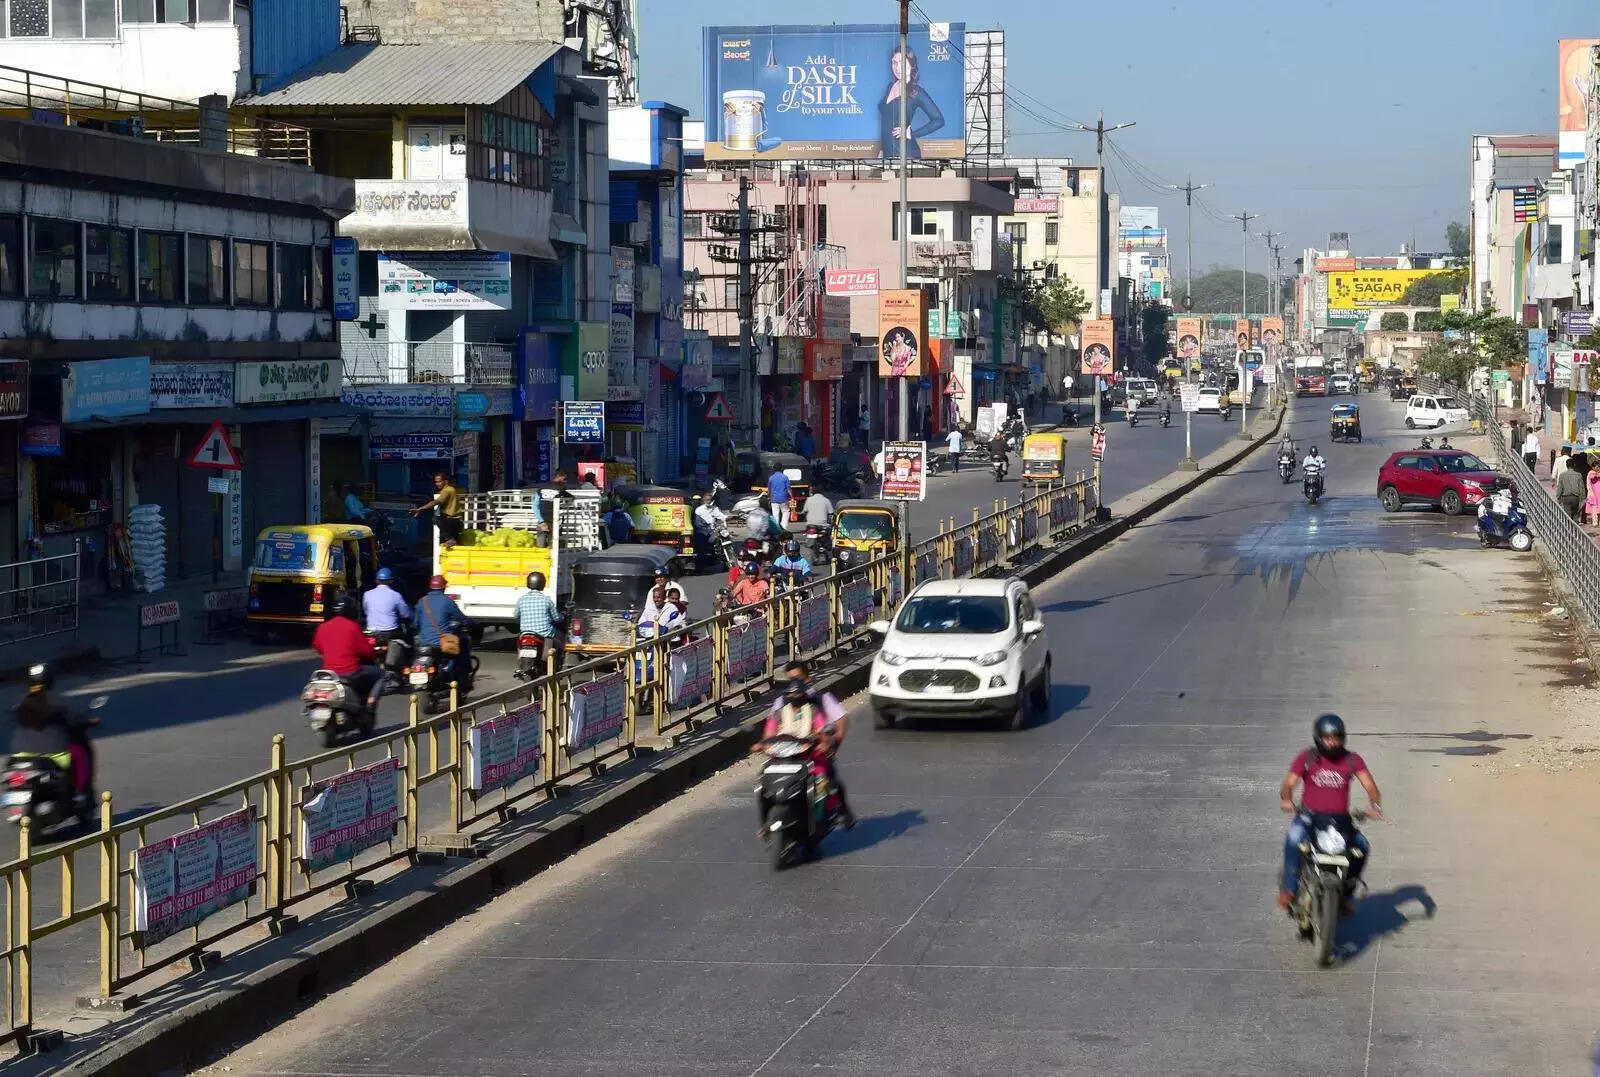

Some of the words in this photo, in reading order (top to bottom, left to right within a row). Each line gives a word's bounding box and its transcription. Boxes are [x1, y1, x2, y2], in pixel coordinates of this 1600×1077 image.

[930, 43, 948, 55] SILK
[805, 56, 826, 65] Add
[927, 54, 951, 62] GLOW
[787, 65, 857, 85] DASH
[777, 82, 802, 113] of
[801, 85, 857, 105] SILK
[802, 105, 812, 115] to
[812, 107, 834, 117] your
[837, 104, 864, 115] walls.
[787, 144, 806, 153] Luxury
[832, 144, 849, 153] Damp
[1034, 200, 1056, 211] LODGE
[828, 273, 877, 285] LOTUS
[1355, 283, 1402, 292] SAGAR
[528, 368, 557, 385] SAMSUNG
